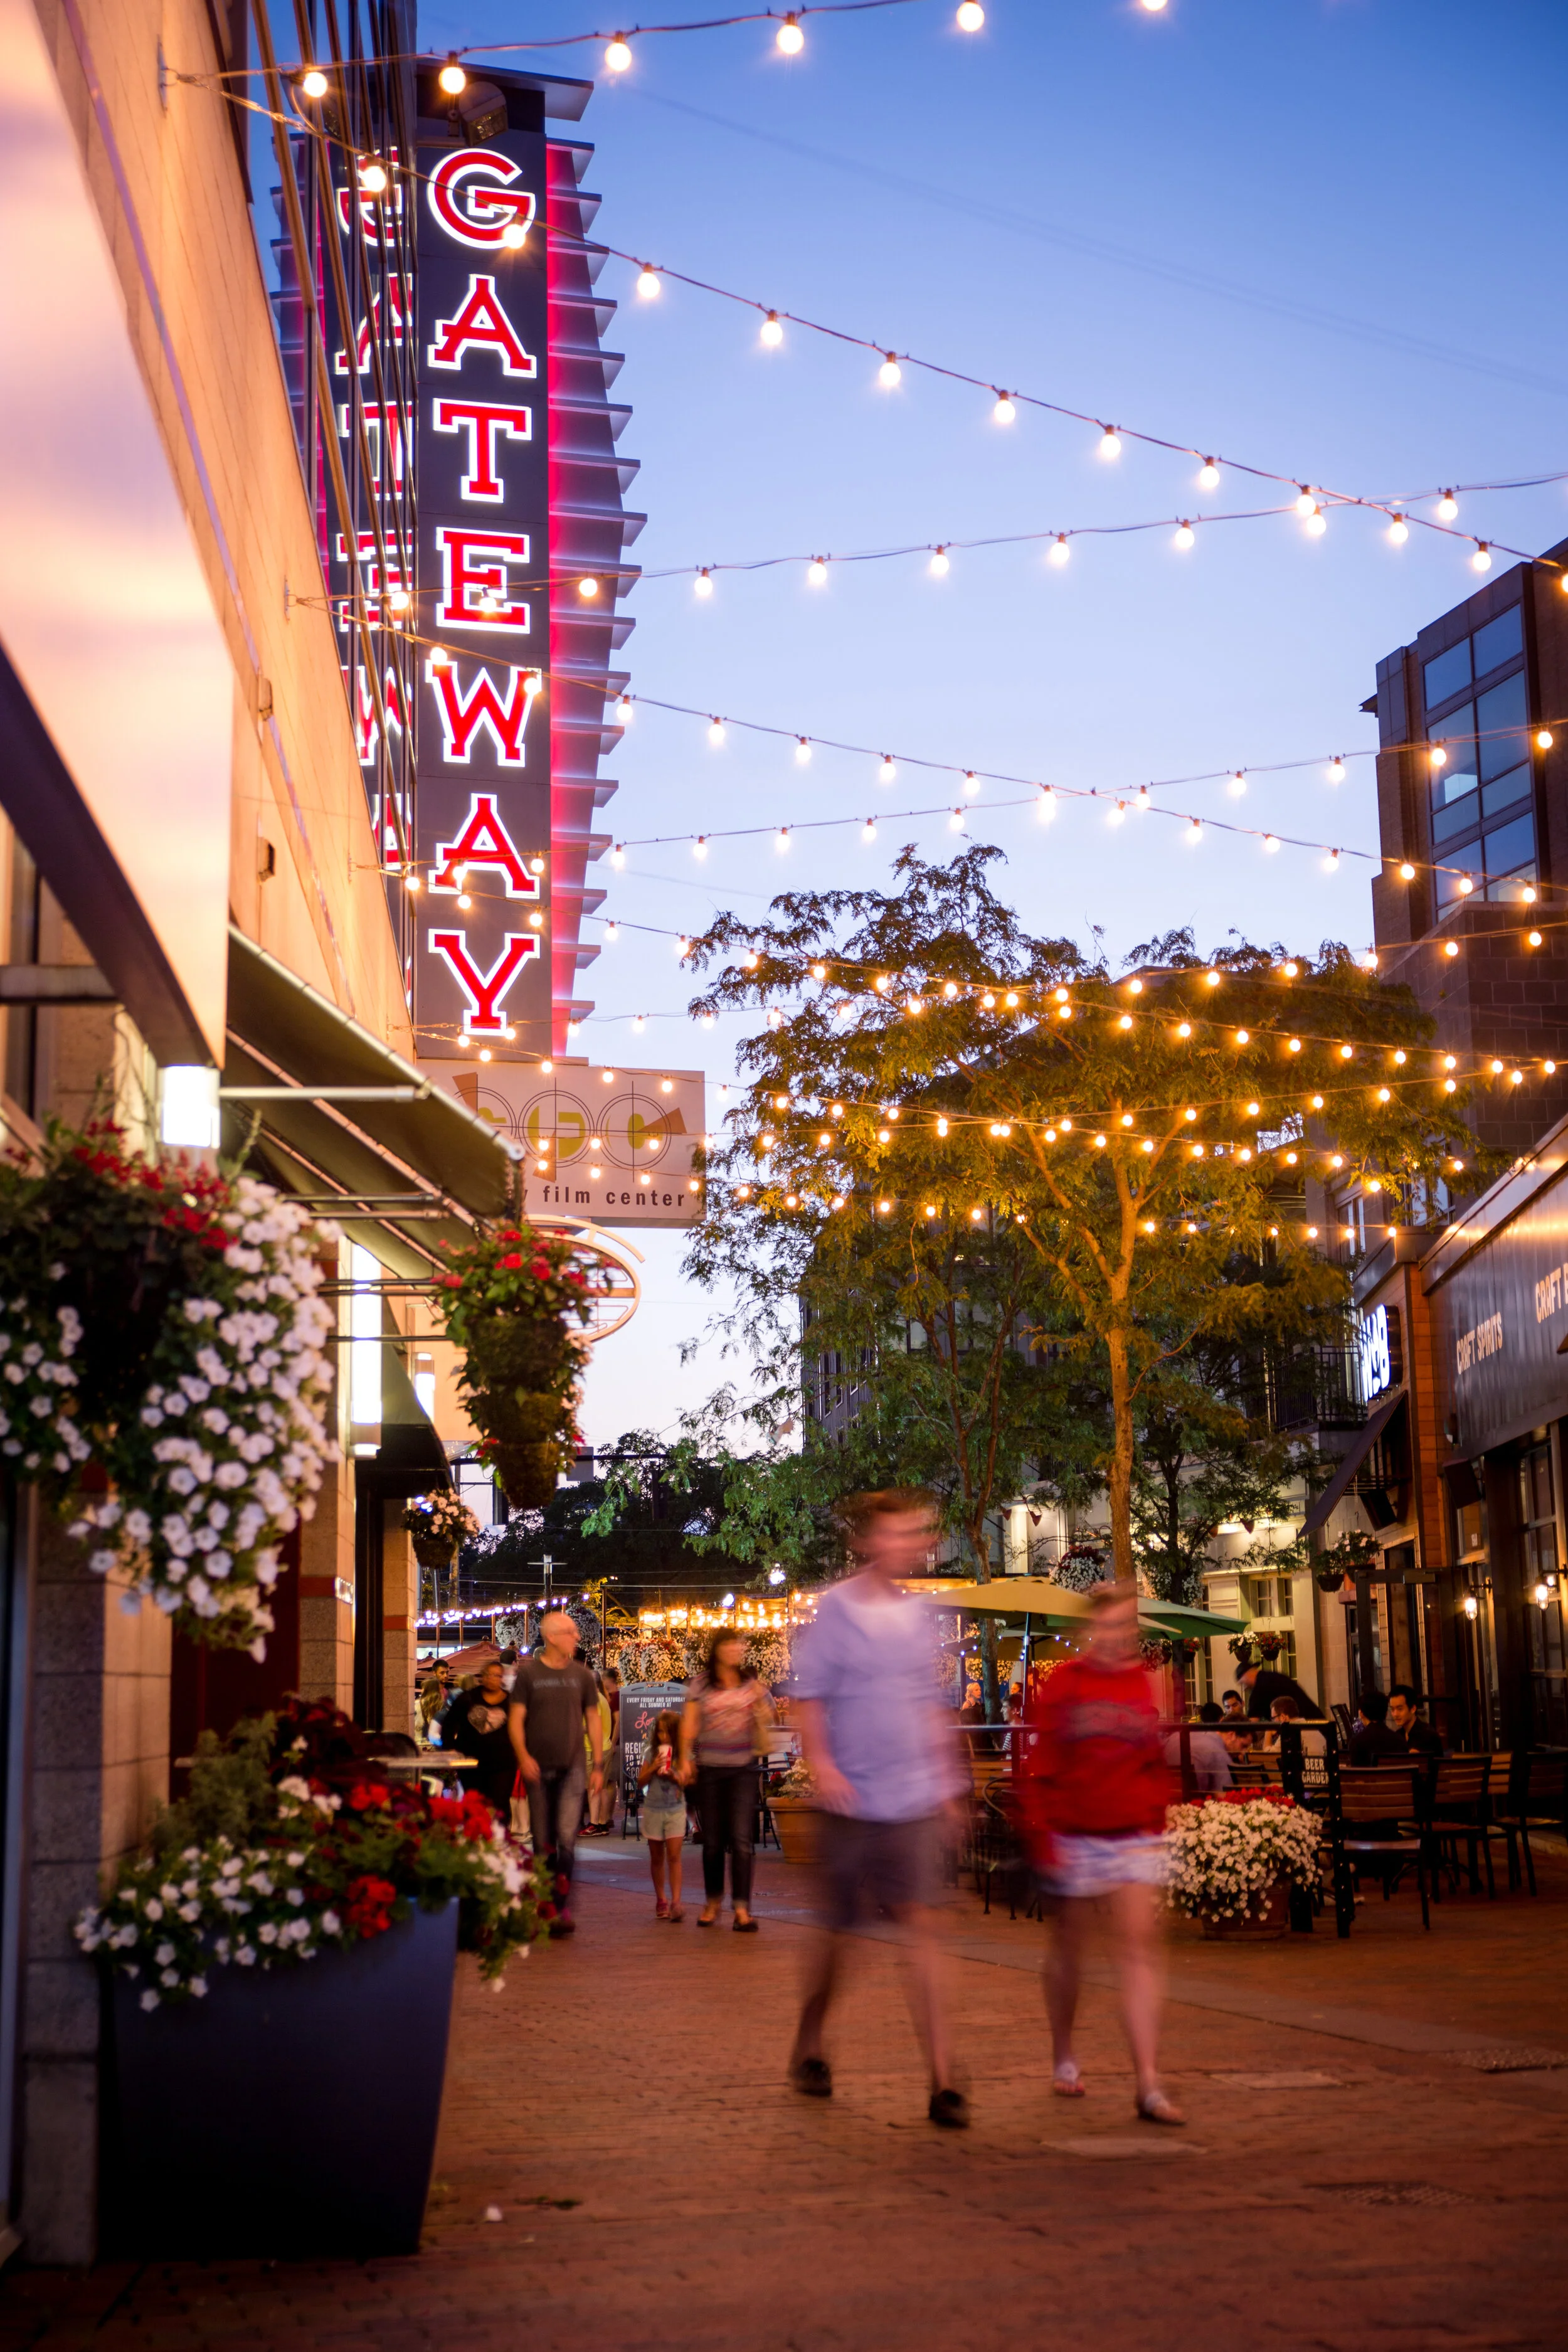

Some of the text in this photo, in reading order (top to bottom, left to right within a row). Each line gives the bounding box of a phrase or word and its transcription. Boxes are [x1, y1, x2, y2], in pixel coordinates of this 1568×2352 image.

[426, 148, 542, 1036] GATEWAY
[543, 1185, 590, 1204] film
[606, 1190, 684, 1207] center
[1535, 1267, 1562, 1324] CRAFT
[1456, 1311, 1503, 1375] CRAFT SPIRITS
[1305, 1758, 1325, 1771] BEER
